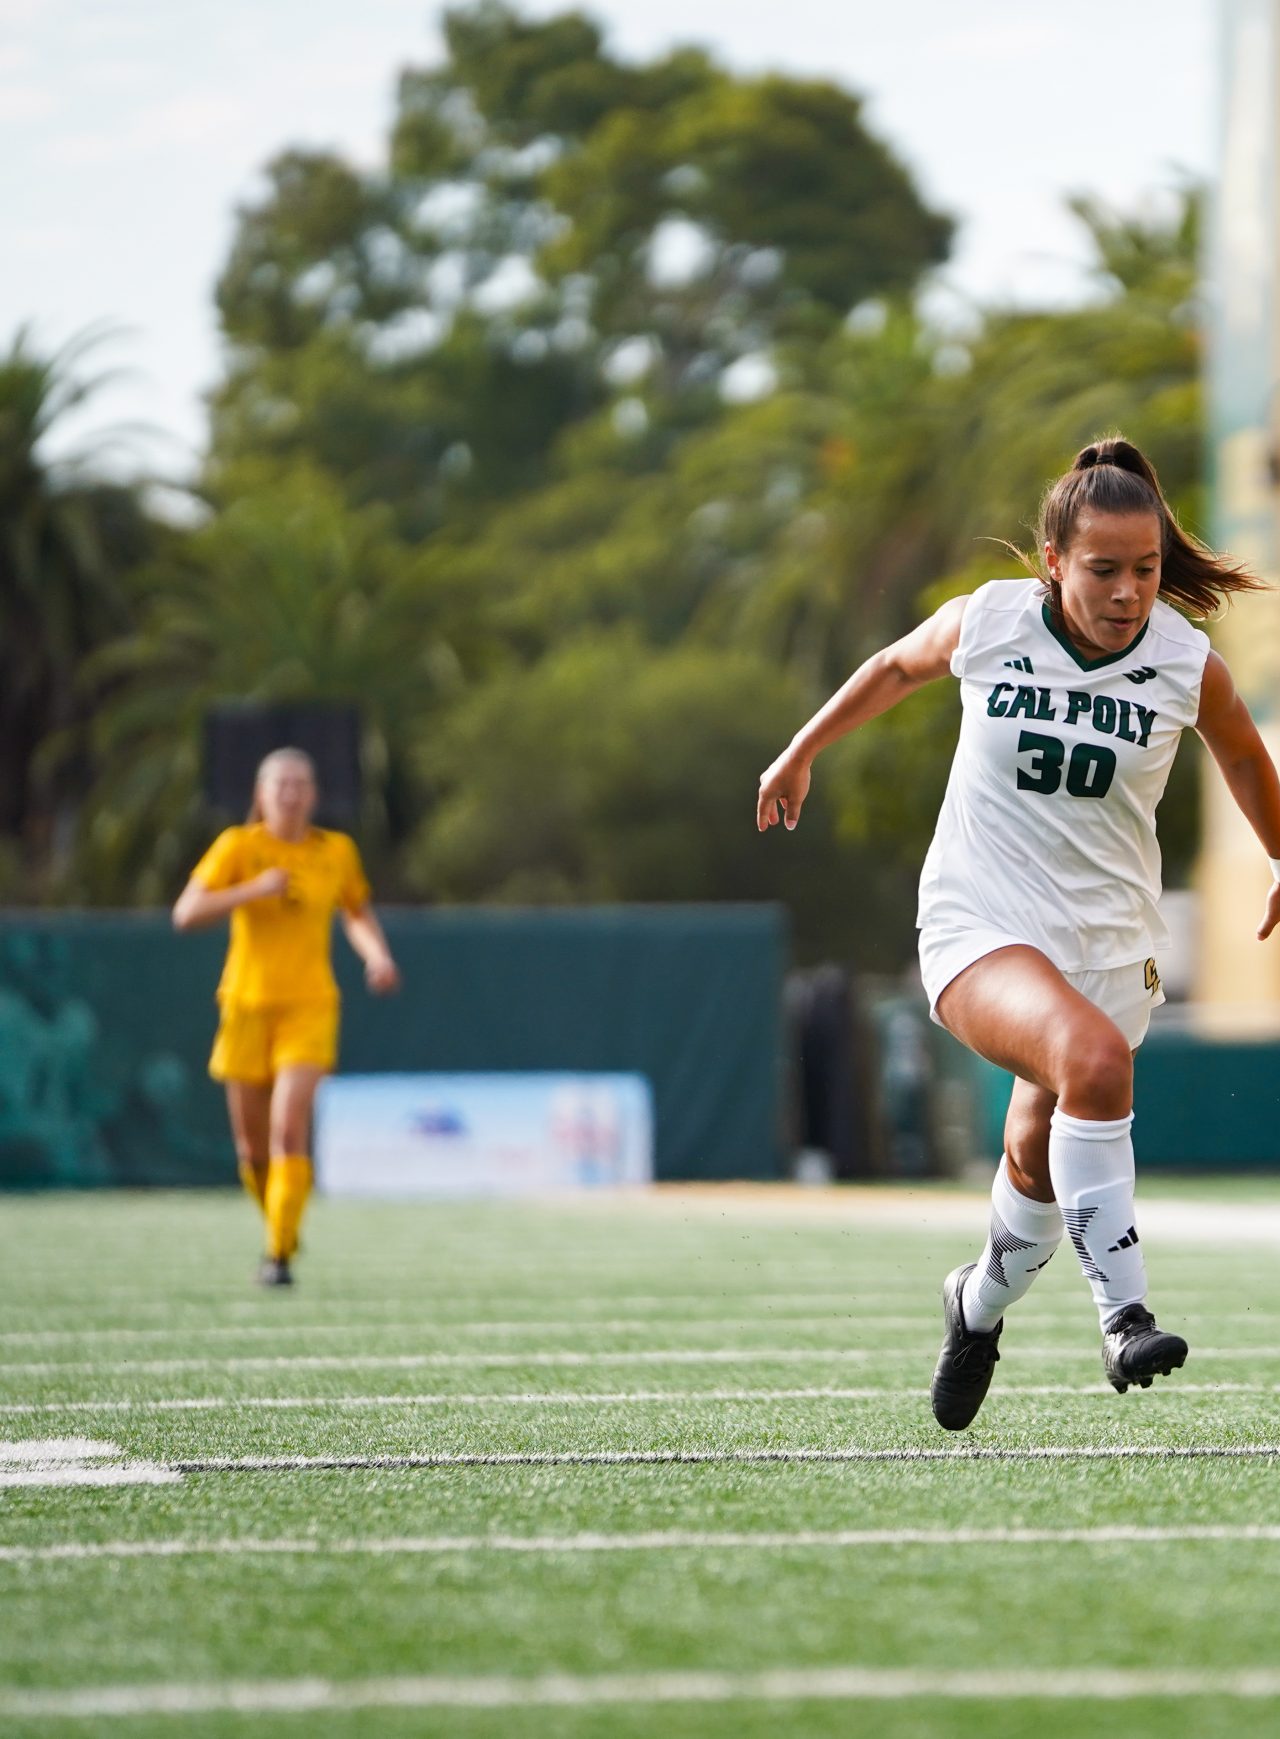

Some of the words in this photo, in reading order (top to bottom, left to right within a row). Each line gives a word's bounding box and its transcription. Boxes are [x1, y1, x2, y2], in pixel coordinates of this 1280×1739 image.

[987, 682, 1057, 721] CAL
[1062, 690, 1159, 748] POLY
[1016, 729, 1117, 799] 30
